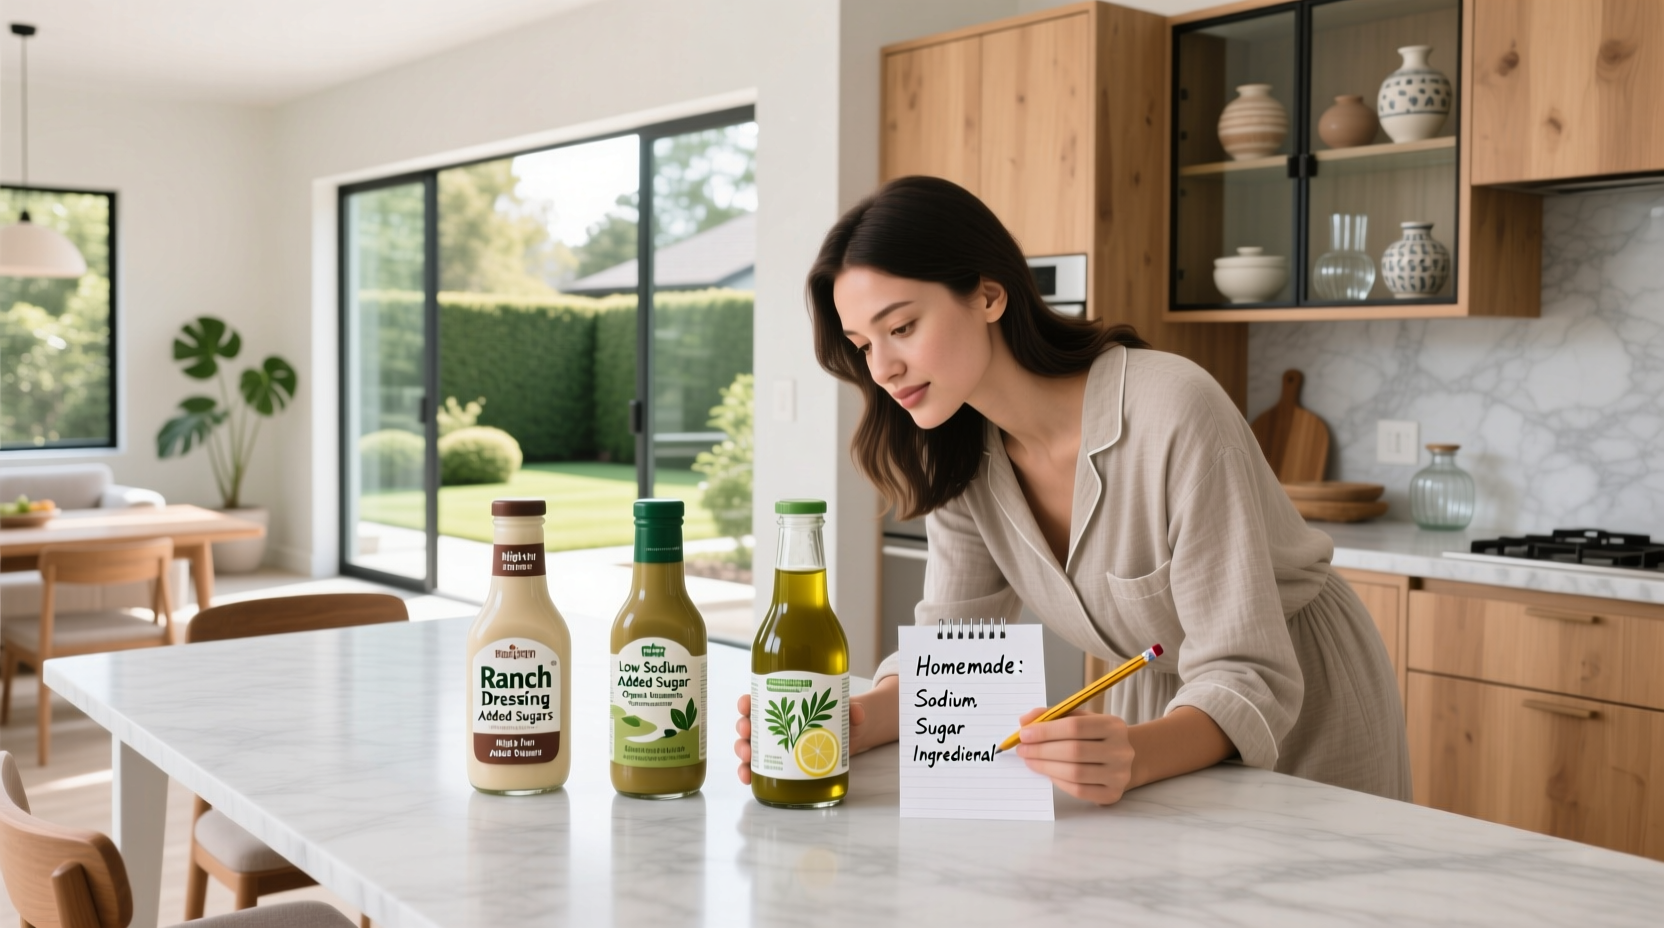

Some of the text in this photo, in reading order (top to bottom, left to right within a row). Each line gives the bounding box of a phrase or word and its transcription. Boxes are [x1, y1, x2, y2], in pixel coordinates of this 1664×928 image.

[619, 661, 640, 673] Low
[916, 654, 1023, 676] Homemade:
[481, 664, 551, 688] Ranch
[618, 675, 691, 691] Added Sugar
[481, 690, 550, 709] Dressing
[478, 710, 553, 724] Added Sugars
[915, 717, 965, 743] Sugar
